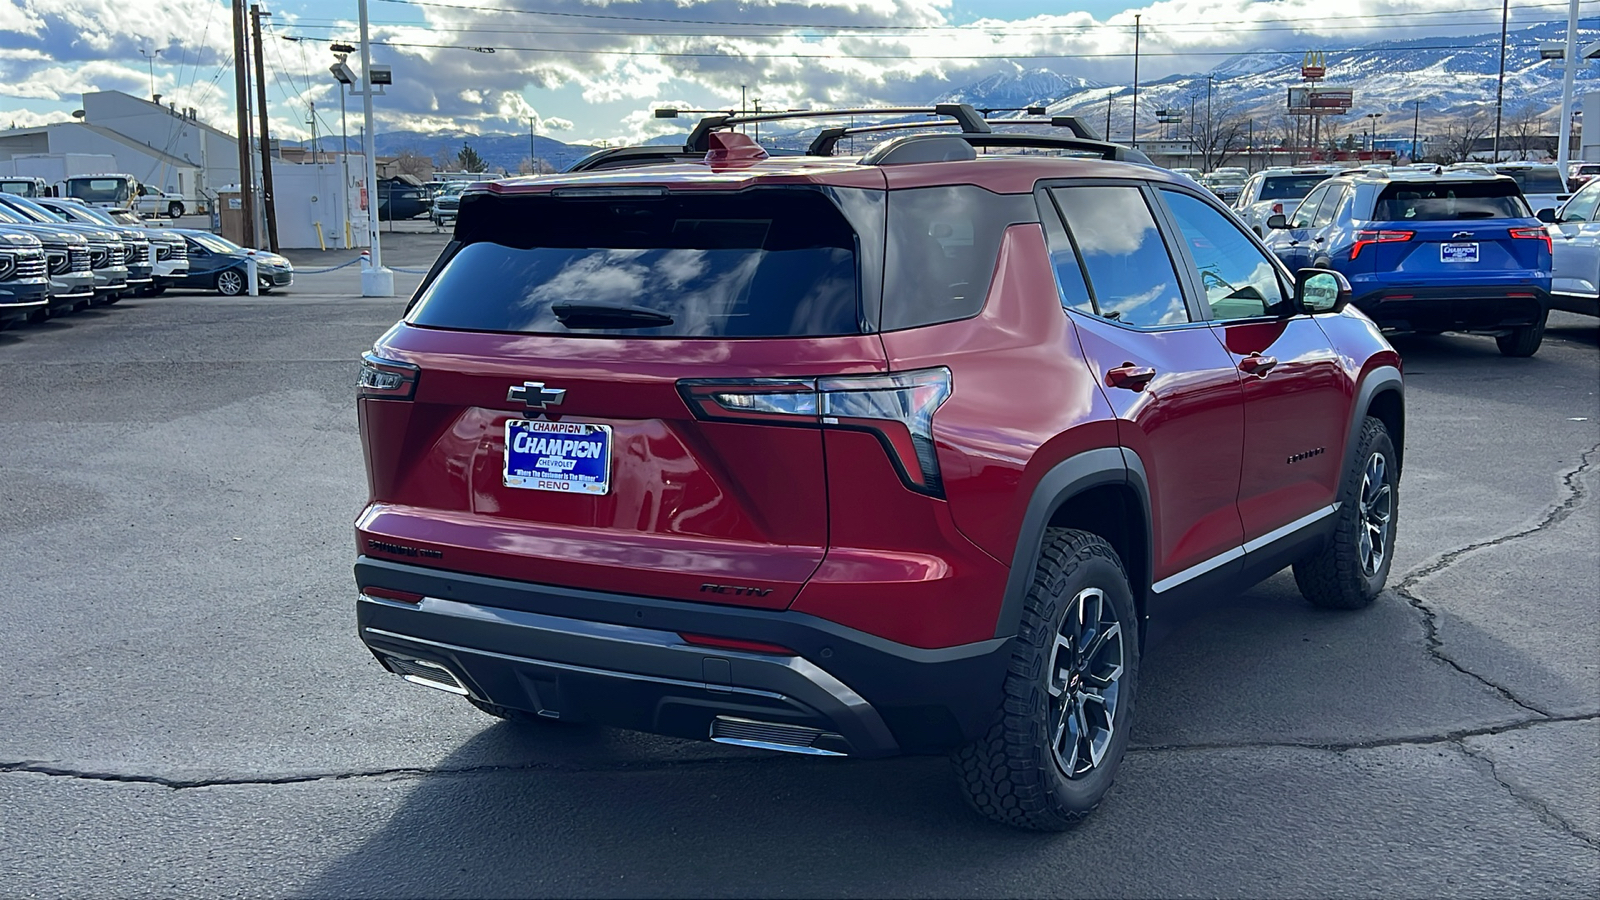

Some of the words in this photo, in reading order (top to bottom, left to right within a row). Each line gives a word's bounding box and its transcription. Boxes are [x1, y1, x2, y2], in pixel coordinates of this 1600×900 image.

[533, 422, 582, 434] CHAMPION
[513, 431, 603, 459] CHAMPION
[539, 459, 574, 468] CHEVROLET
[538, 481, 570, 490] RENO
[700, 582, 774, 597] ACTIV
